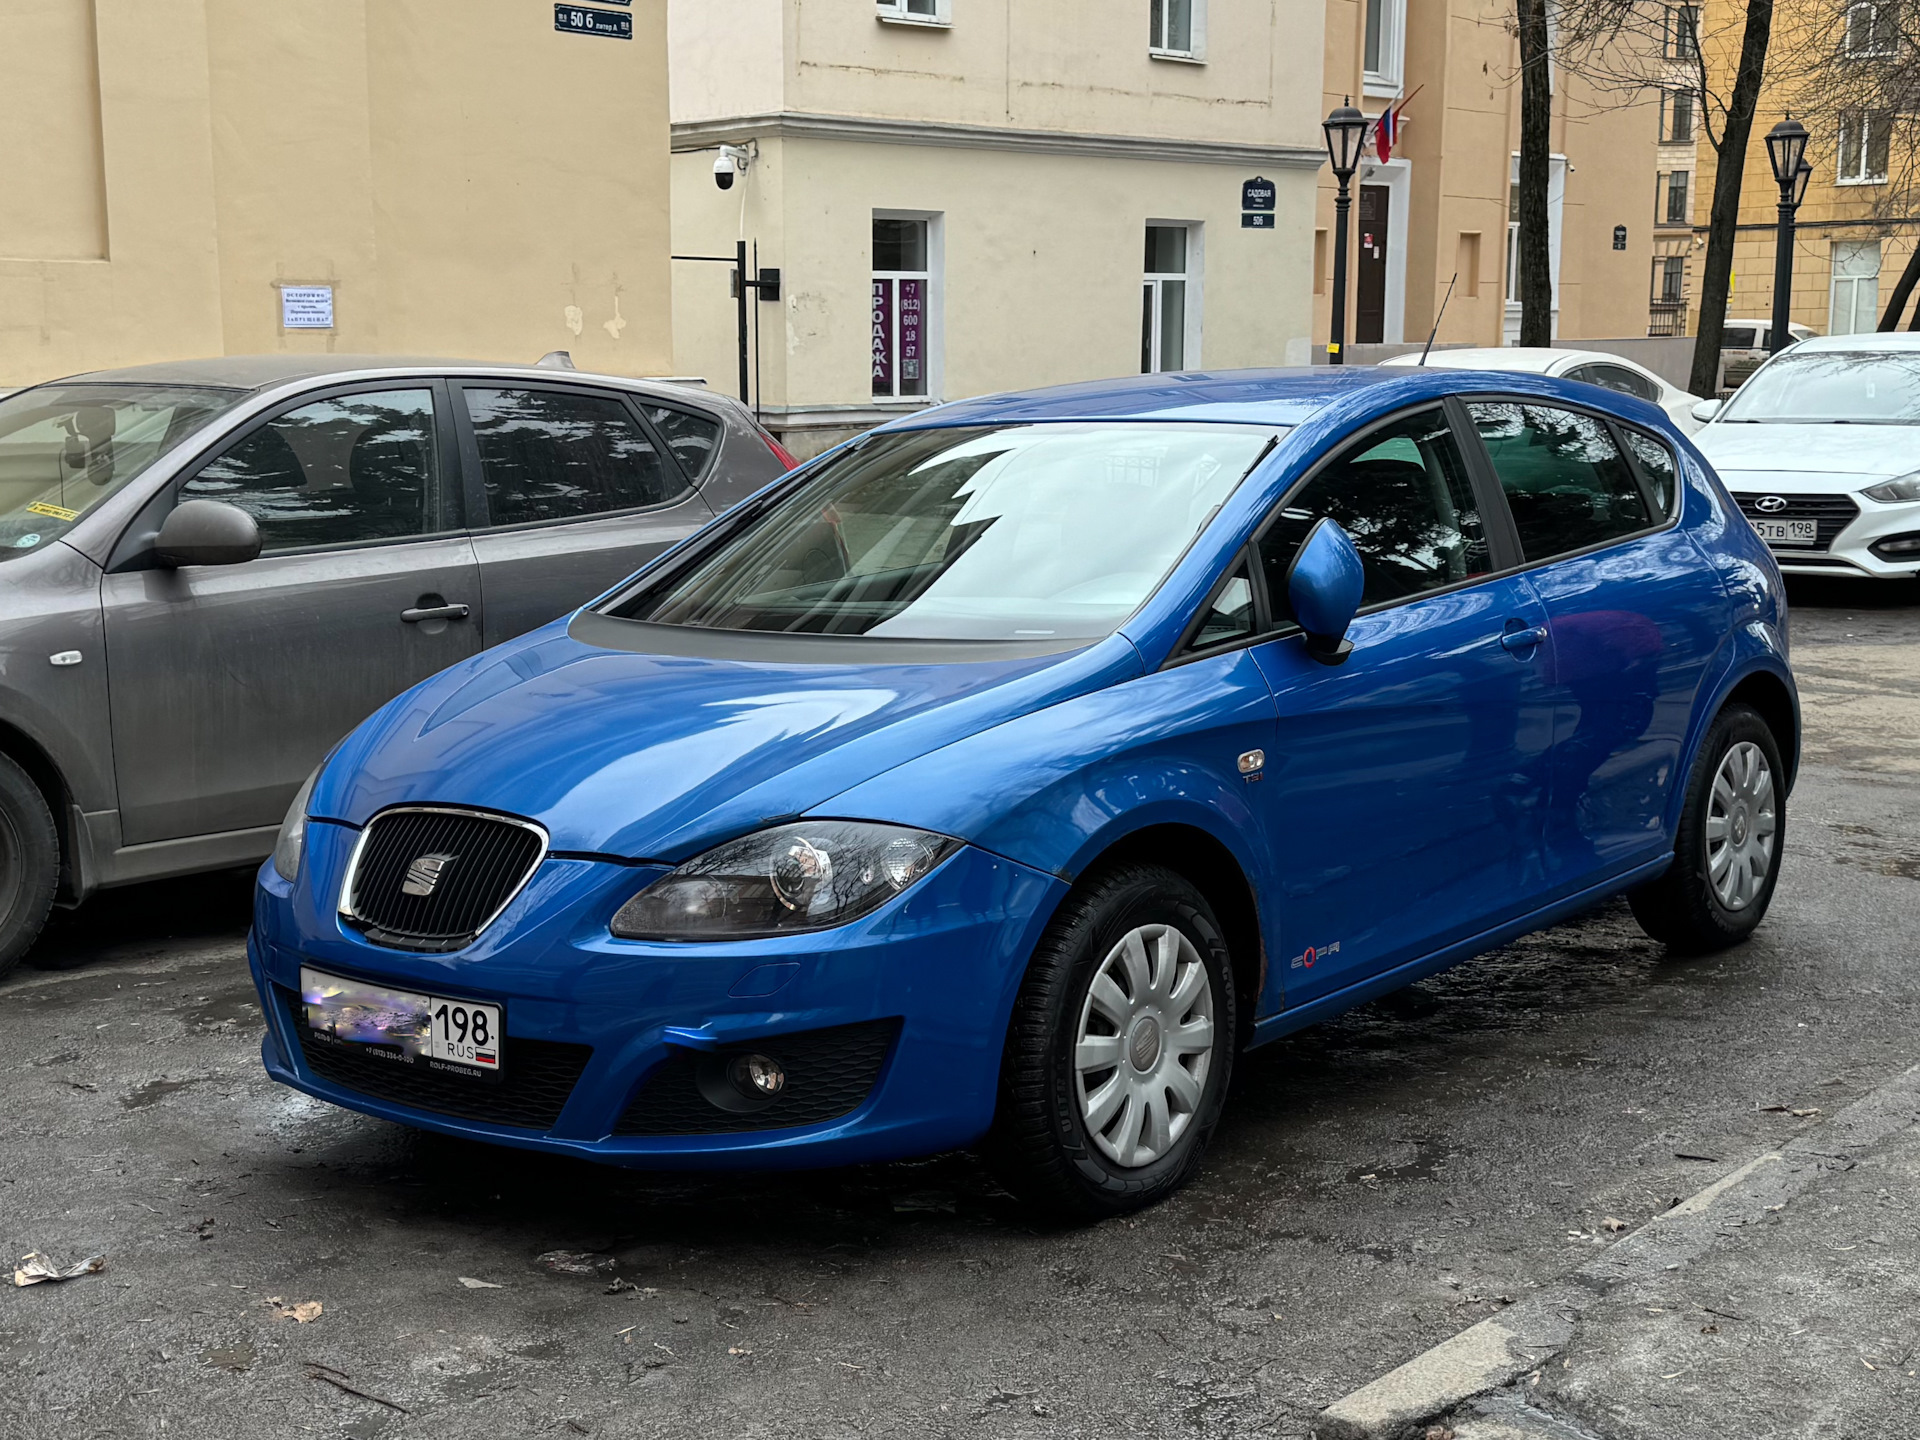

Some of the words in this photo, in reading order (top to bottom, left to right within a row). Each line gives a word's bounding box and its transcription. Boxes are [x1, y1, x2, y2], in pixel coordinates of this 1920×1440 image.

[570, 11, 584, 27] 50
[905, 283, 916, 294] +7
[901, 299, 921, 312] (812)
[903, 315, 918, 326] 600
[872, 283, 888, 378] ПРОДАЖА
[905, 331, 916, 342] 18
[905, 346, 916, 357] 57
[1789, 522, 1812, 534] 198
[435, 1004, 489, 1046] 198
[447, 1042, 475, 1060] RUS
